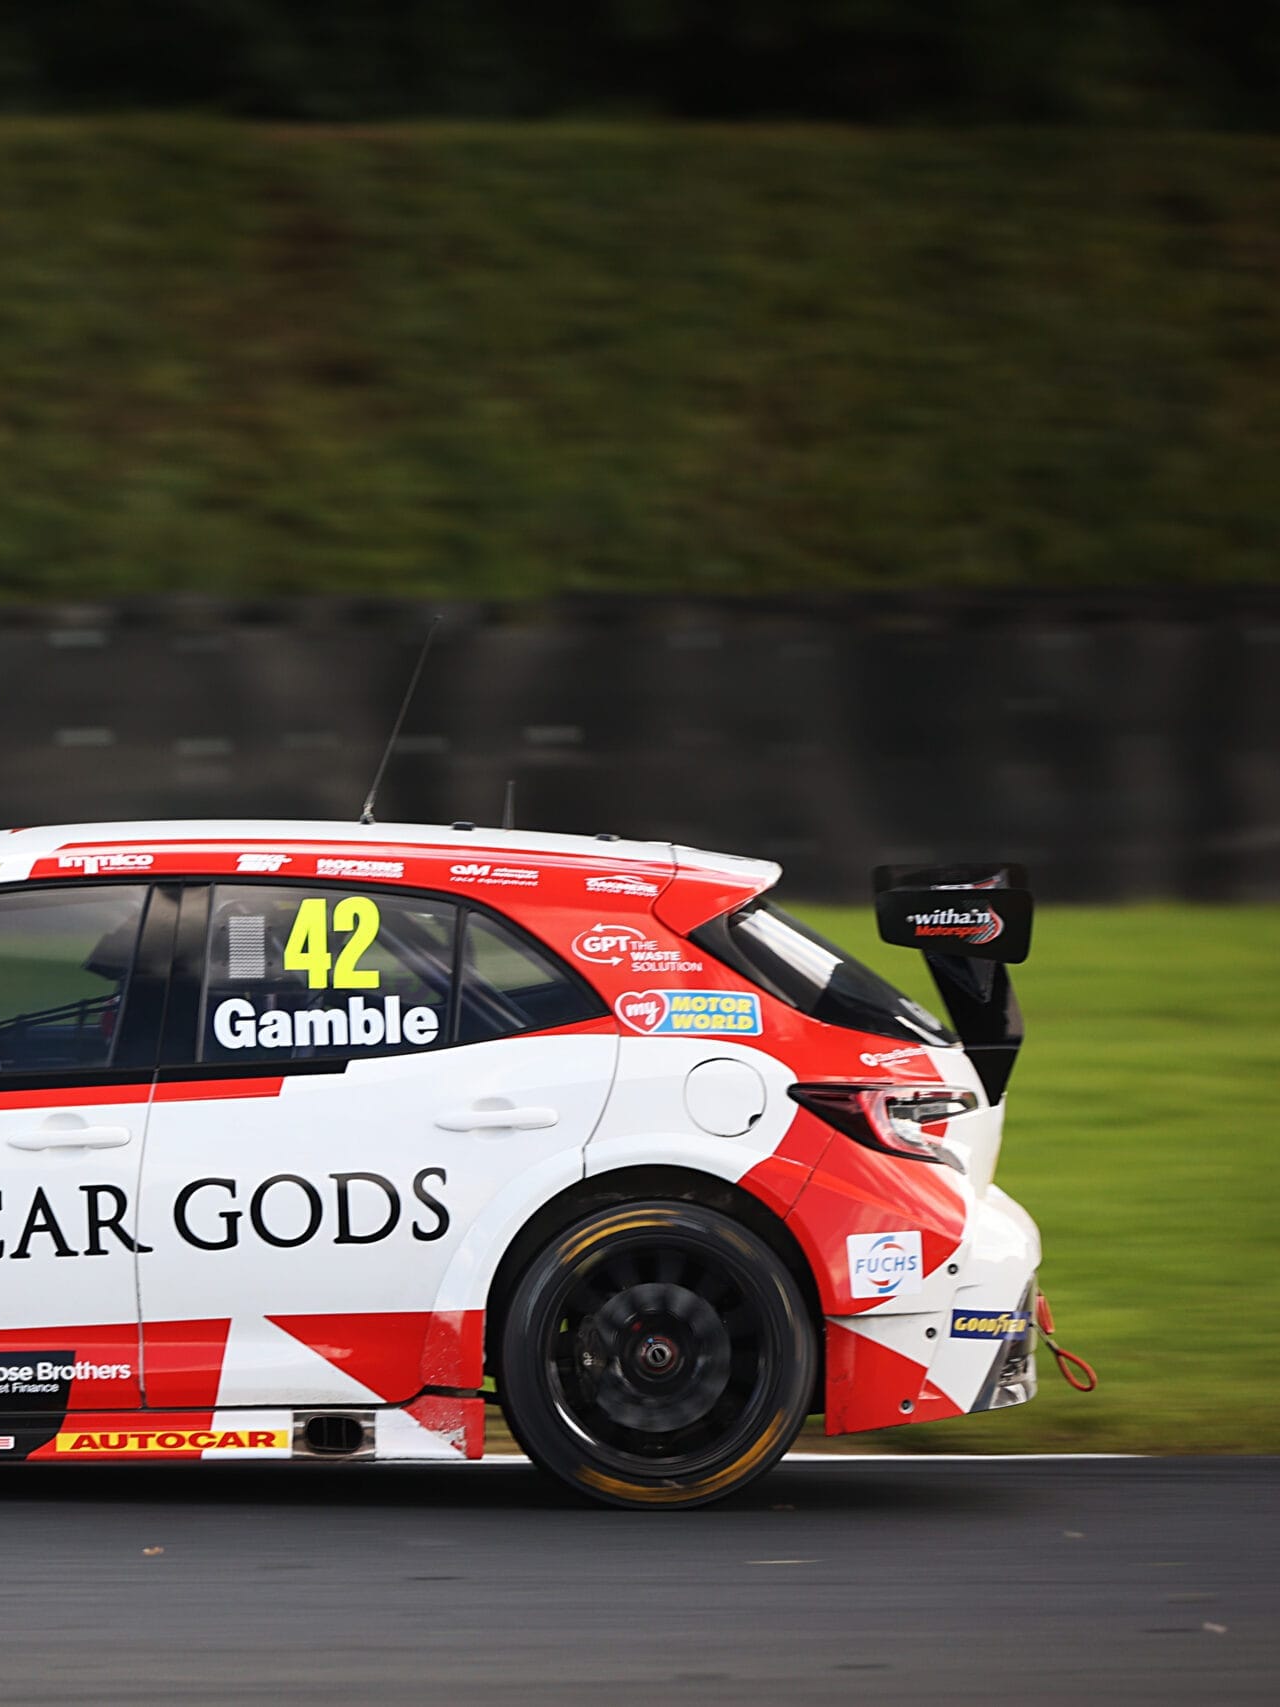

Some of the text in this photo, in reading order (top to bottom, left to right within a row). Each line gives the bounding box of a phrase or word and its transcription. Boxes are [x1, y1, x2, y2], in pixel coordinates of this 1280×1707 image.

[284, 896, 380, 989] 42
[583, 936, 631, 952] GPT
[631, 940, 658, 951] THE
[631, 951, 680, 961] WASTE
[631, 961, 703, 972] SOLUTION
[625, 1000, 660, 1026] my
[670, 996, 753, 1013] MOTOR
[213, 995, 439, 1049] Gamble
[670, 1014, 754, 1030] WORLD
[173, 1167, 450, 1251] GODS
[855, 1255, 917, 1274] FUCHS
[37, 1362, 131, 1381] Brothers
[12, 1382, 59, 1393] Finance
[70, 1431, 276, 1449] AUTOCAR
